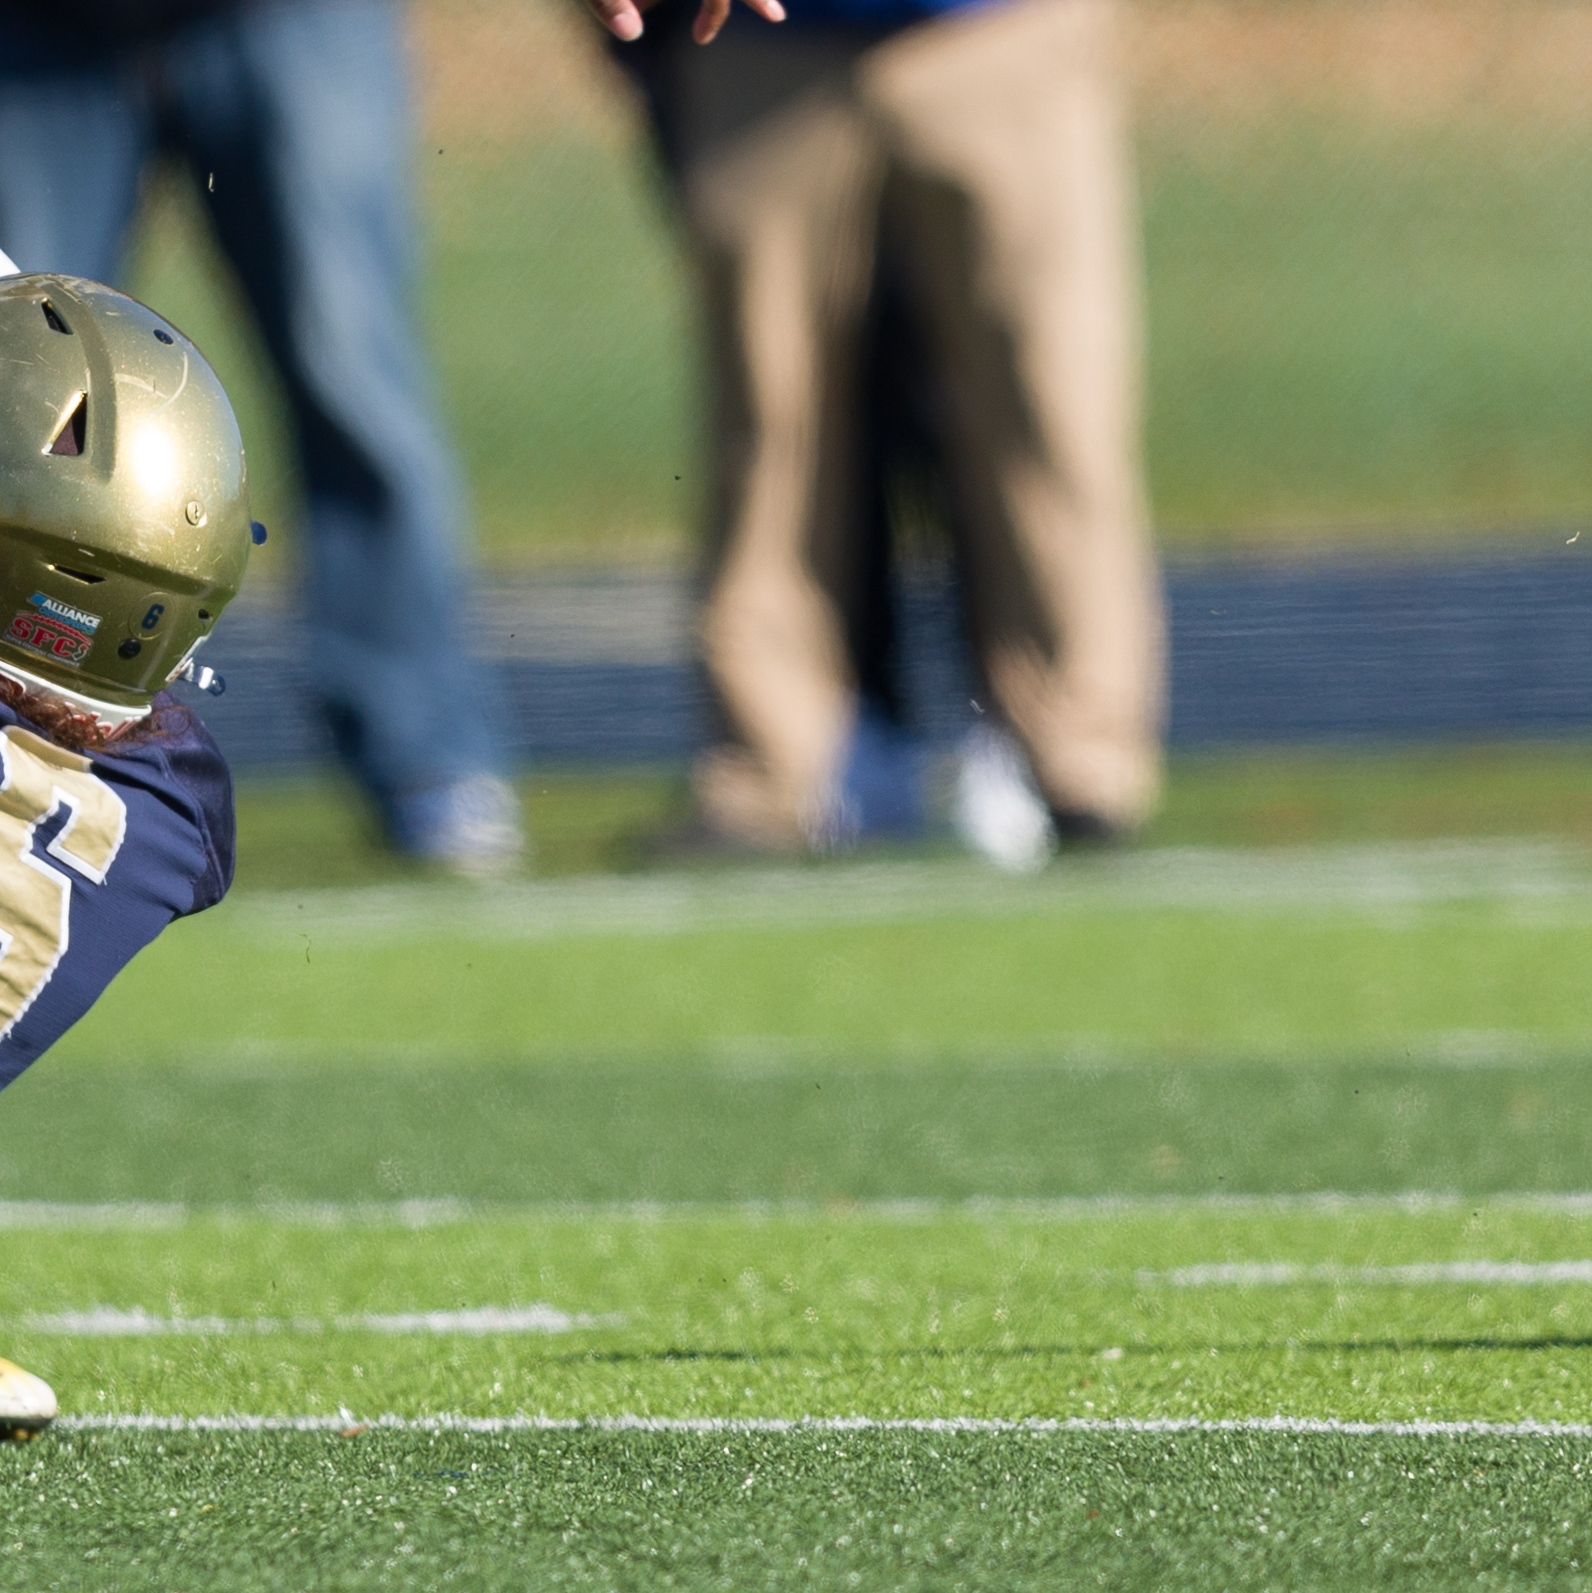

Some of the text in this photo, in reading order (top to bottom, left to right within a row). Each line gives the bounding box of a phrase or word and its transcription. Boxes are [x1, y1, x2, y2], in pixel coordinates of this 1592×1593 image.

[41, 597, 100, 628] ALLIANCE
[141, 603, 165, 630] 6
[9, 616, 77, 658] SFC
